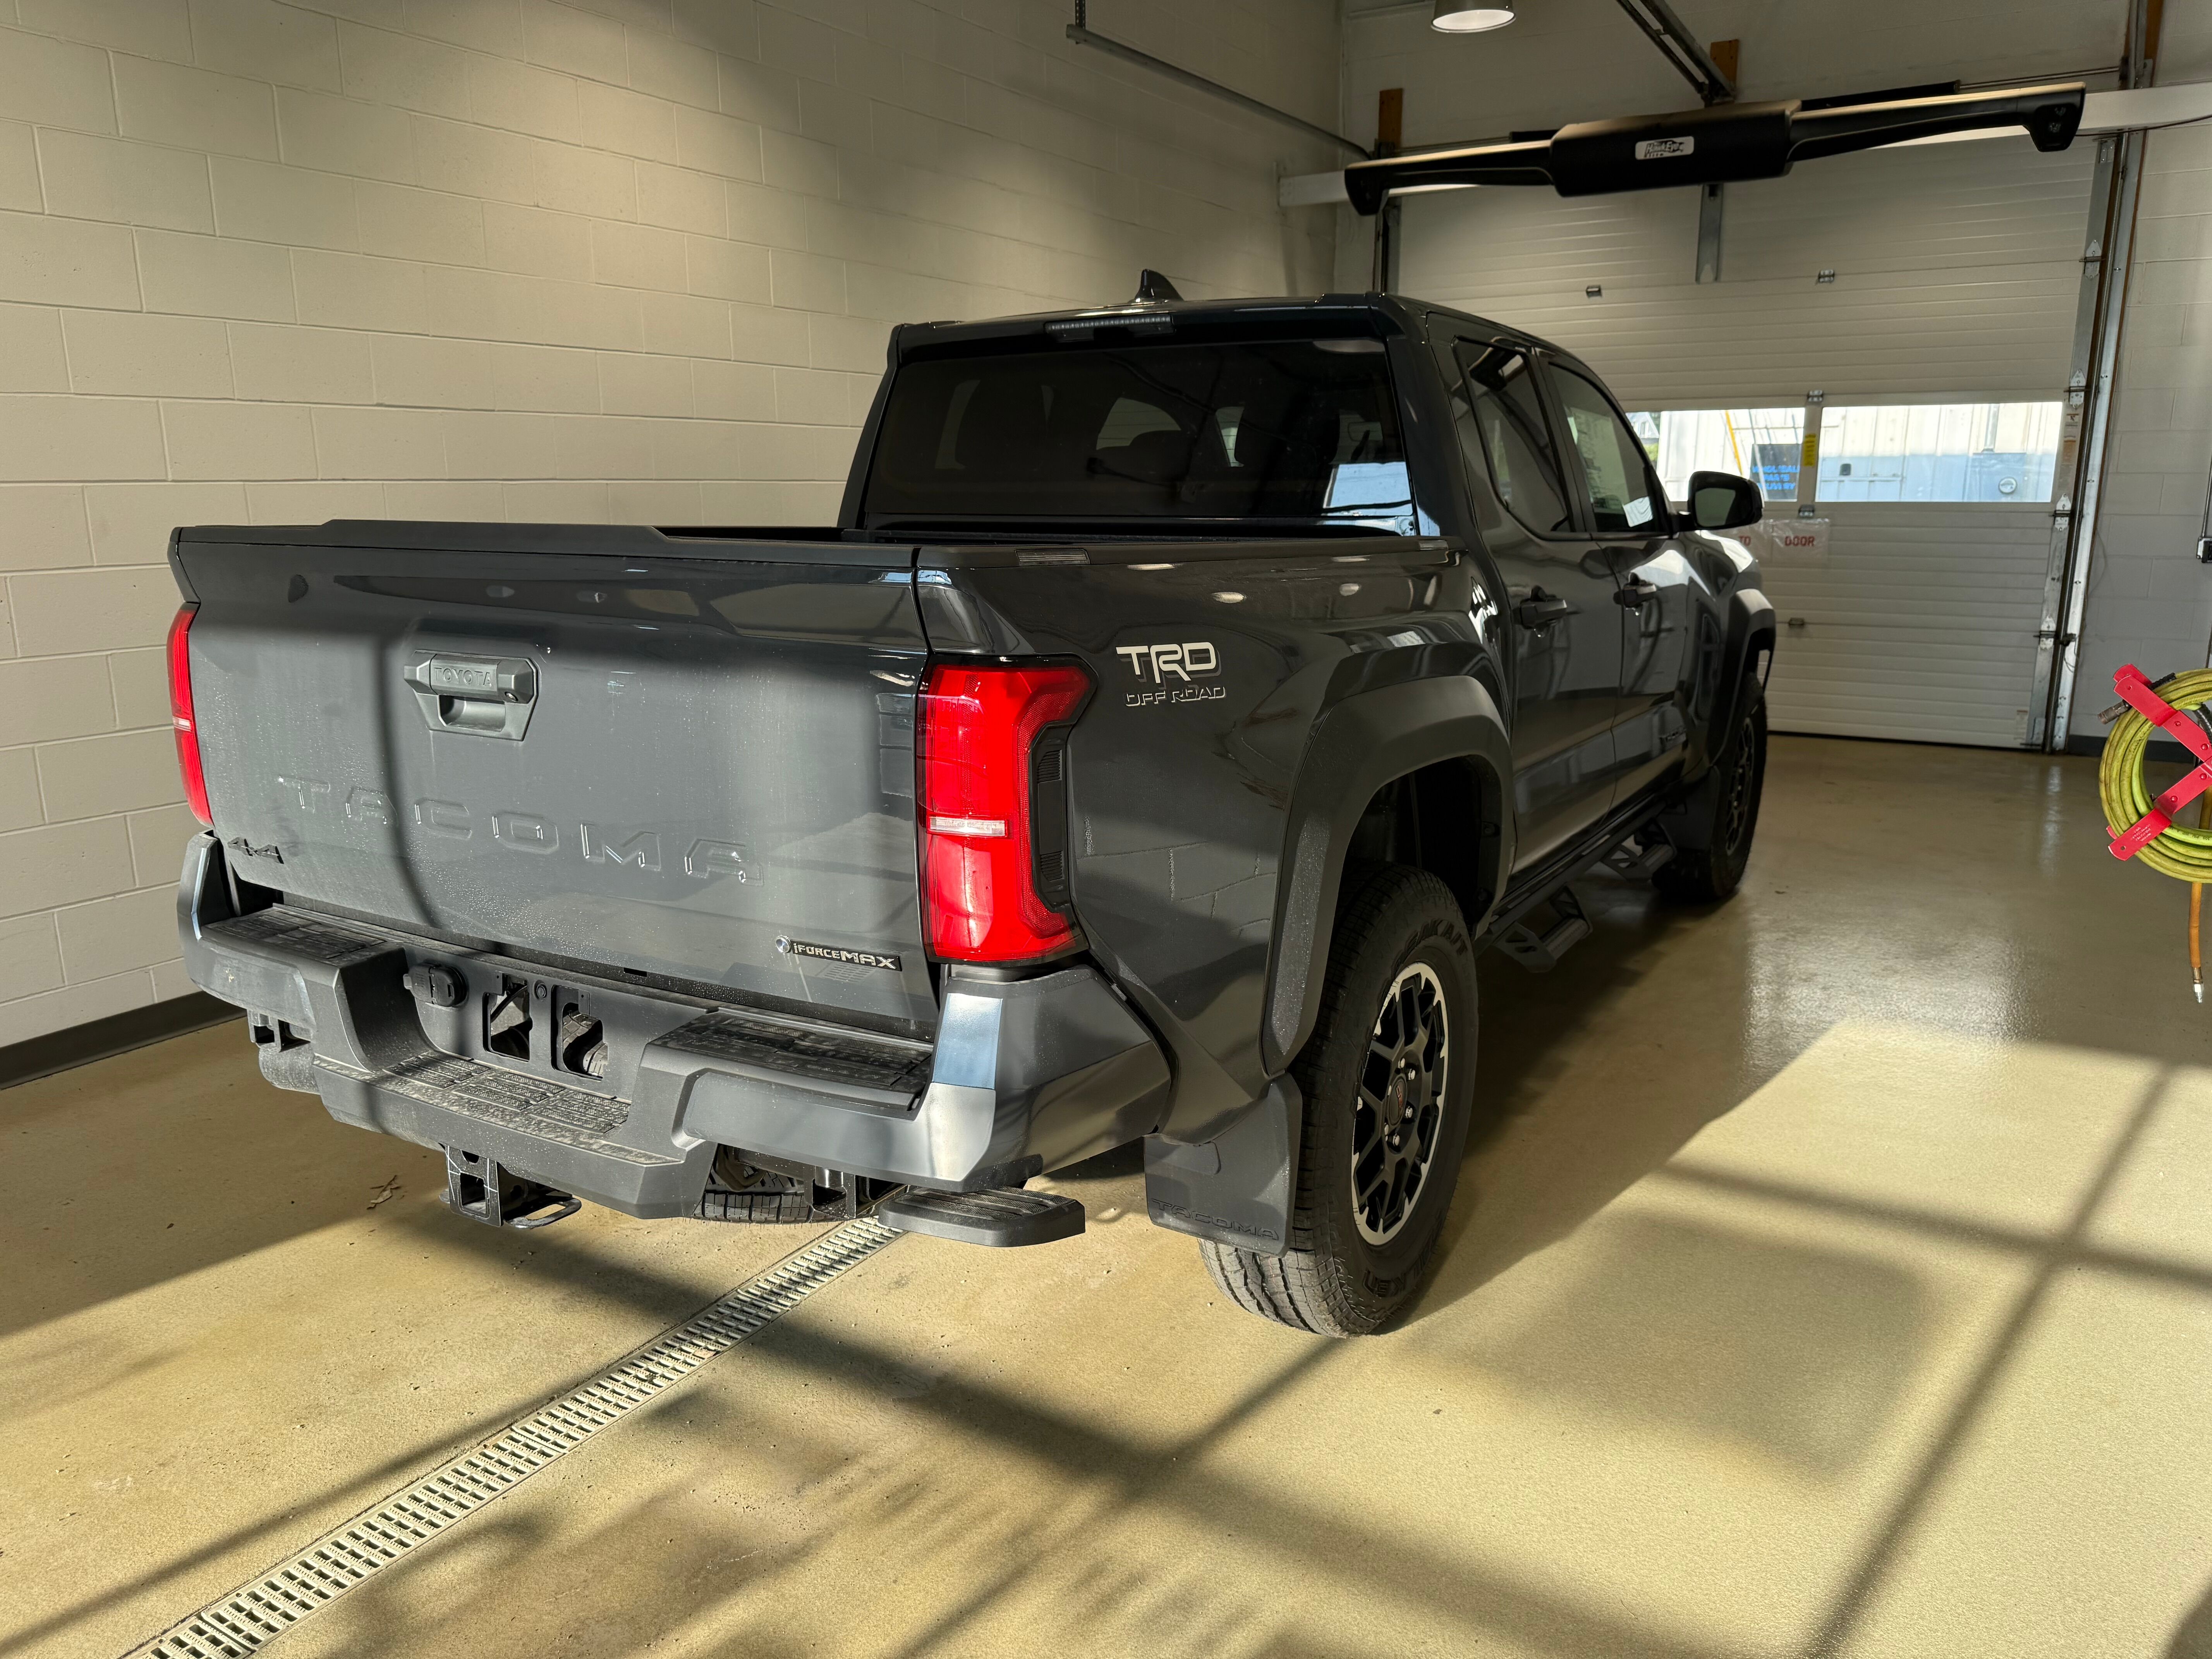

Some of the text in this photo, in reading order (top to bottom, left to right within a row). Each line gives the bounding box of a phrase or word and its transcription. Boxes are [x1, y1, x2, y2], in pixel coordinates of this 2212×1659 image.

[1738, 536, 1815, 546] TO DOOR
[433, 666, 492, 687] TOYOTA
[1116, 641, 1216, 684] TRD
[1125, 686, 1226, 706] OFF ROAD
[277, 775, 764, 886] TACOMA
[1152, 1198, 1279, 1240] TACOMA
